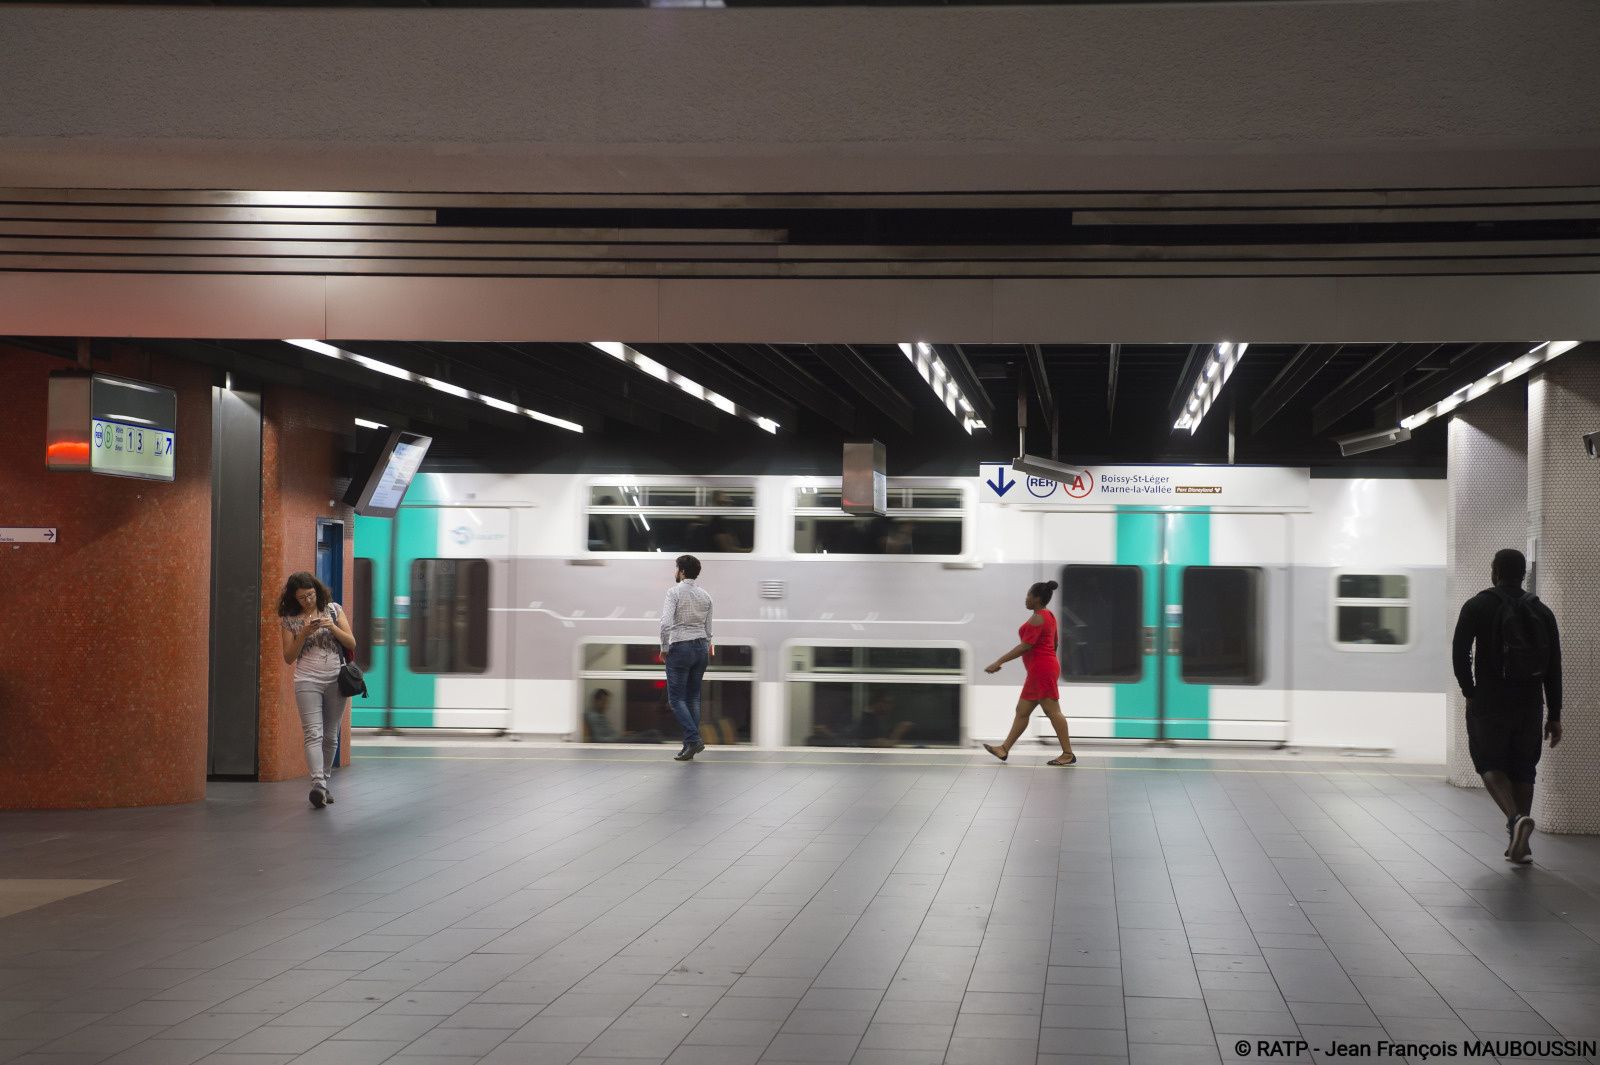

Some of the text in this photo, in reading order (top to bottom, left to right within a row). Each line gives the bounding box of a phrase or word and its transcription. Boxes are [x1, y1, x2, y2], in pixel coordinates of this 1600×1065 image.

[137, 433, 143, 450] 3
[1030, 475, 1085, 490] RER A
[1101, 474, 1170, 484] Boissy-St-Léger
[1101, 485, 1172, 494] Marne-la-Vallée
